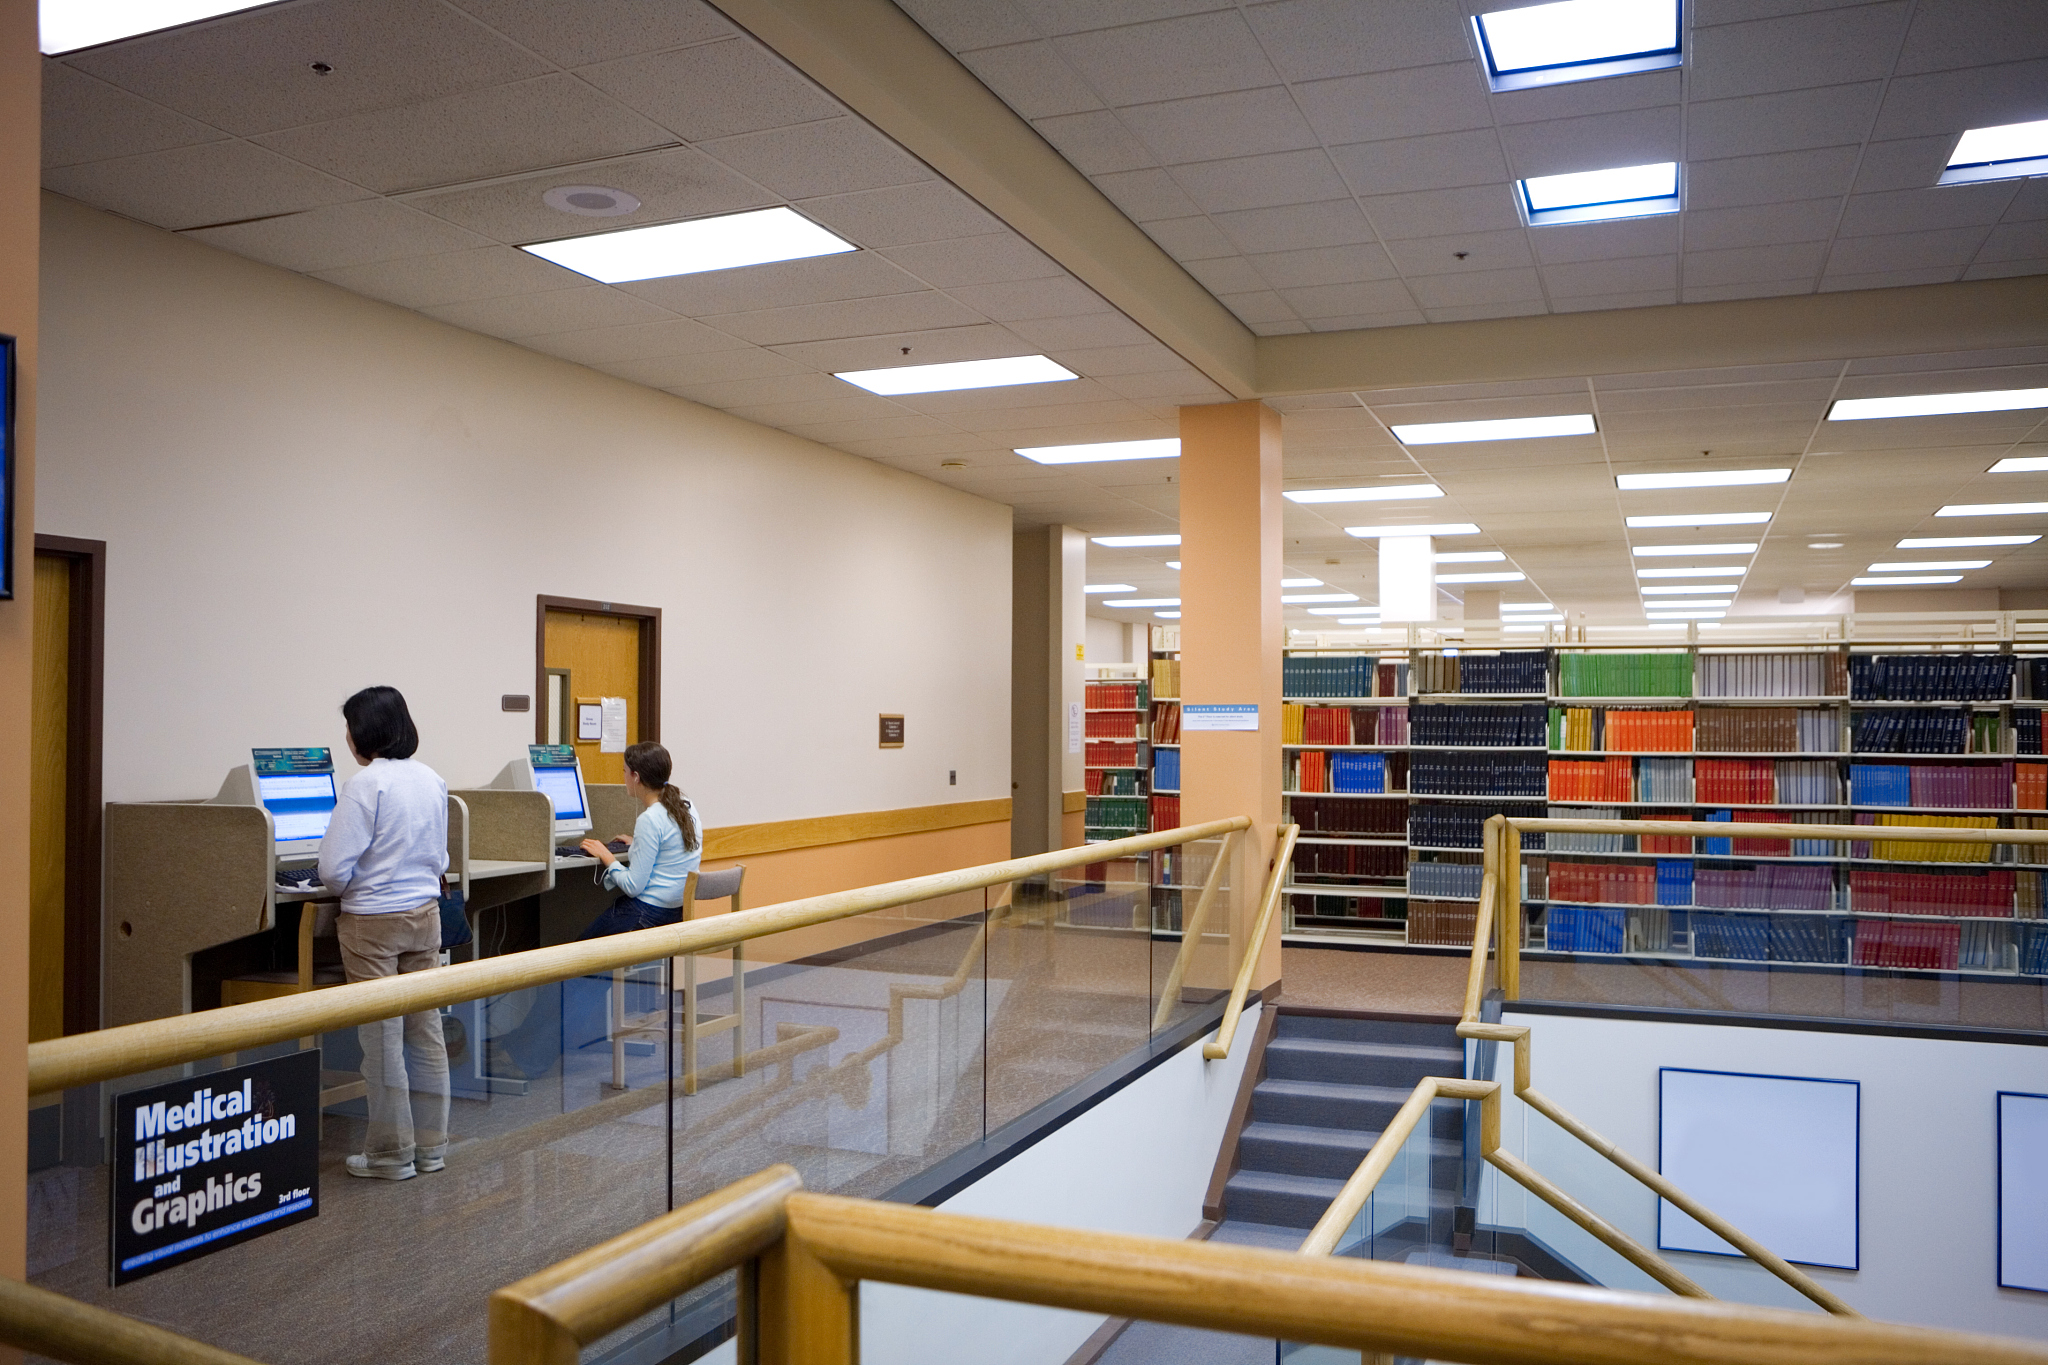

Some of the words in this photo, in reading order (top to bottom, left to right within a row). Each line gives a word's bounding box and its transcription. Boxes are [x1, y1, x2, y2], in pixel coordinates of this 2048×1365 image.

[135, 1078, 252, 1141] Medical
[134, 1113, 296, 1182] Illustration
[131, 1172, 262, 1235] Graphics
[154, 1174, 181, 1198] and
[278, 1191, 291, 1204] 3rd
[292, 1187, 311, 1199] floor
[155, 1245, 173, 1258] visual
[174, 1234, 204, 1251] materials
[204, 1232, 212, 1240] to
[212, 1222, 241, 1238] enhance
[242, 1213, 273, 1227] education
[273, 1208, 286, 1217] and
[286, 1199, 311, 1212] research
